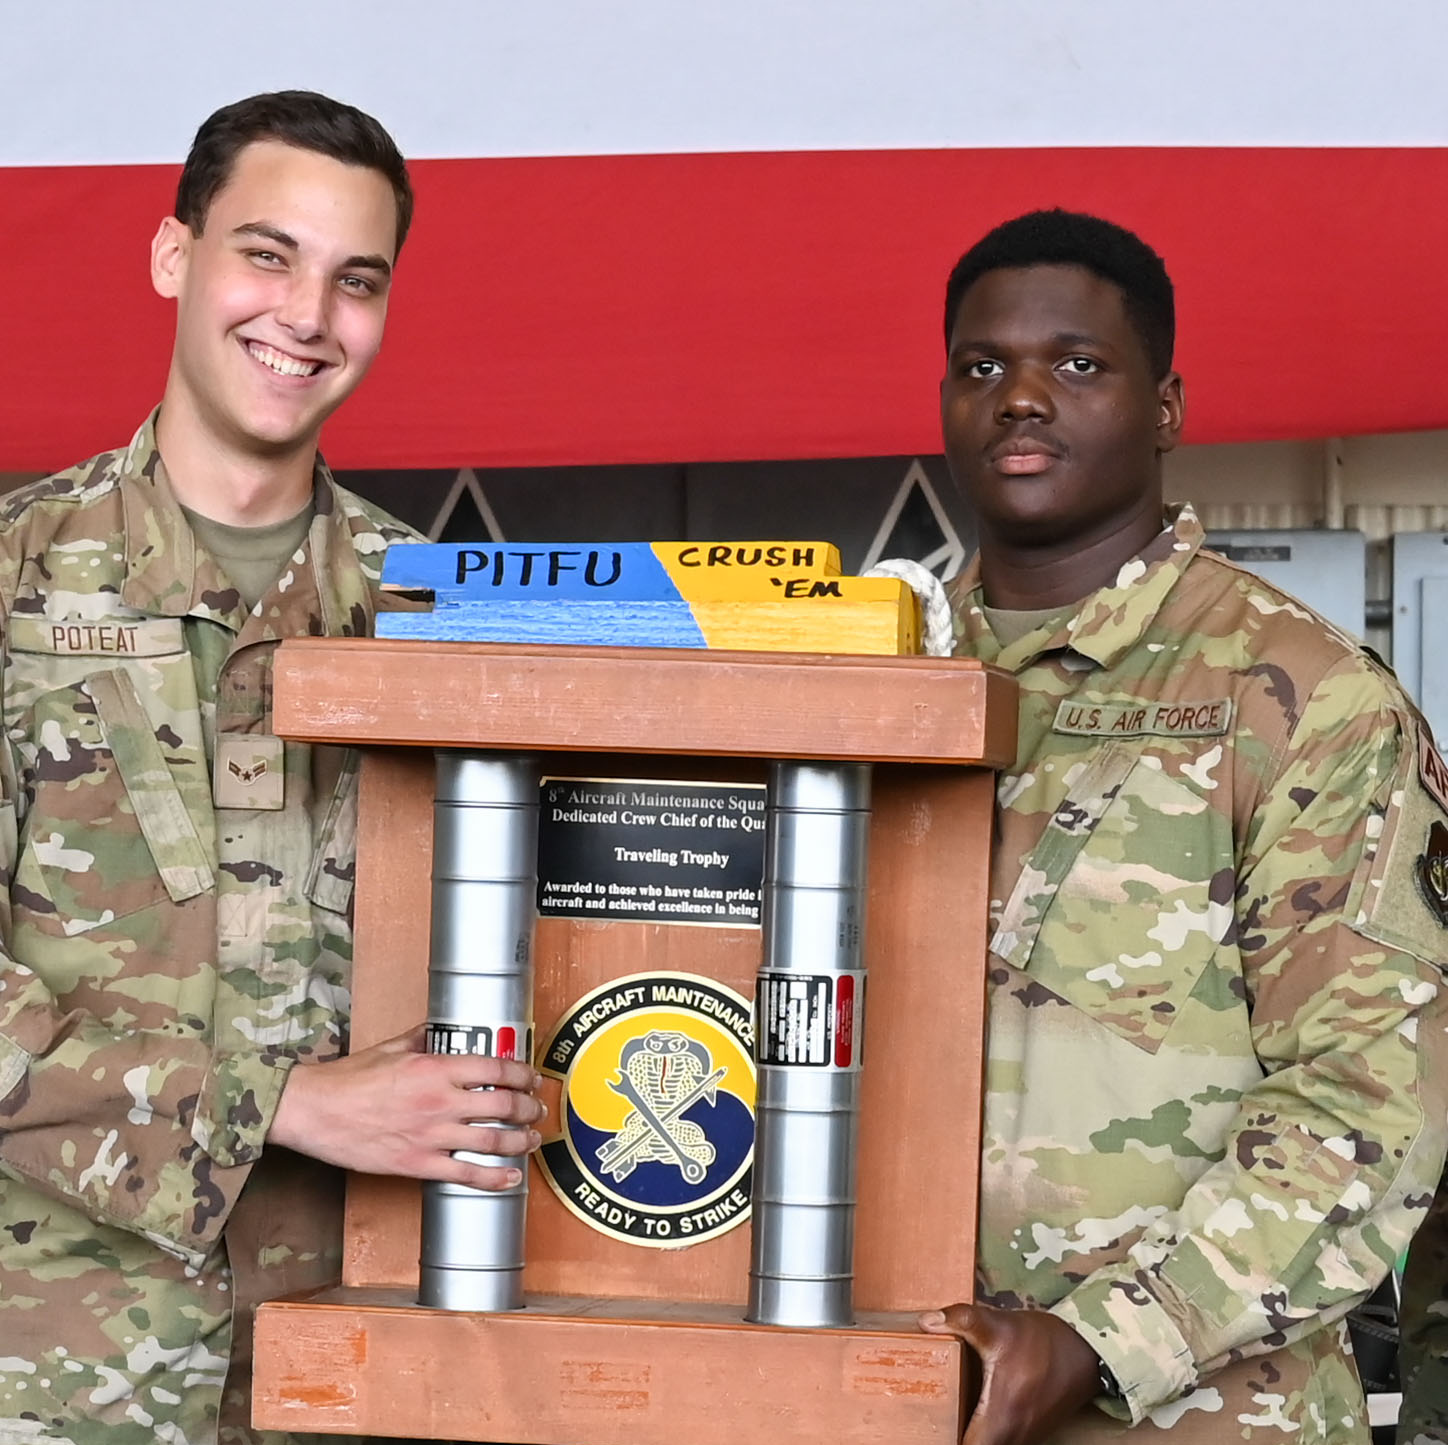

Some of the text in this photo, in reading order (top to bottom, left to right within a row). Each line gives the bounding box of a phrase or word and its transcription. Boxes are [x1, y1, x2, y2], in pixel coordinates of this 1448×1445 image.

[455, 550, 622, 587] PITFU
[678, 547, 814, 568] CRUSH
[771, 577, 843, 598] 'EM
[52, 626, 138, 652] POTEAT
[1065, 705, 1221, 731] U.S. AIR FORCE
[568, 789, 627, 806] Aircraft
[630, 791, 725, 810] Maintenance
[552, 808, 617, 824] Dedicated
[620, 810, 657, 826] Crew
[660, 812, 698, 828] Chief
[699, 814, 715, 828] of
[716, 814, 738, 829] the
[614, 847, 730, 869] Traveling Trophy
[544, 881, 593, 894] Awarded
[594, 883, 607, 894] to
[608, 882, 637, 896] those
[638, 884, 663, 897] who
[664, 885, 691, 898] have
[692, 886, 723, 900] taken
[725, 888, 756, 903] pride
[542, 896, 759, 919] aircraft and achieved excellence in being
[552, 1038, 575, 1064] 8th
[572, 986, 646, 1038] AIRCRAFT
[651, 985, 756, 1048] MAINTENANCE
[574, 1182, 749, 1236] READY TO STRIKE
